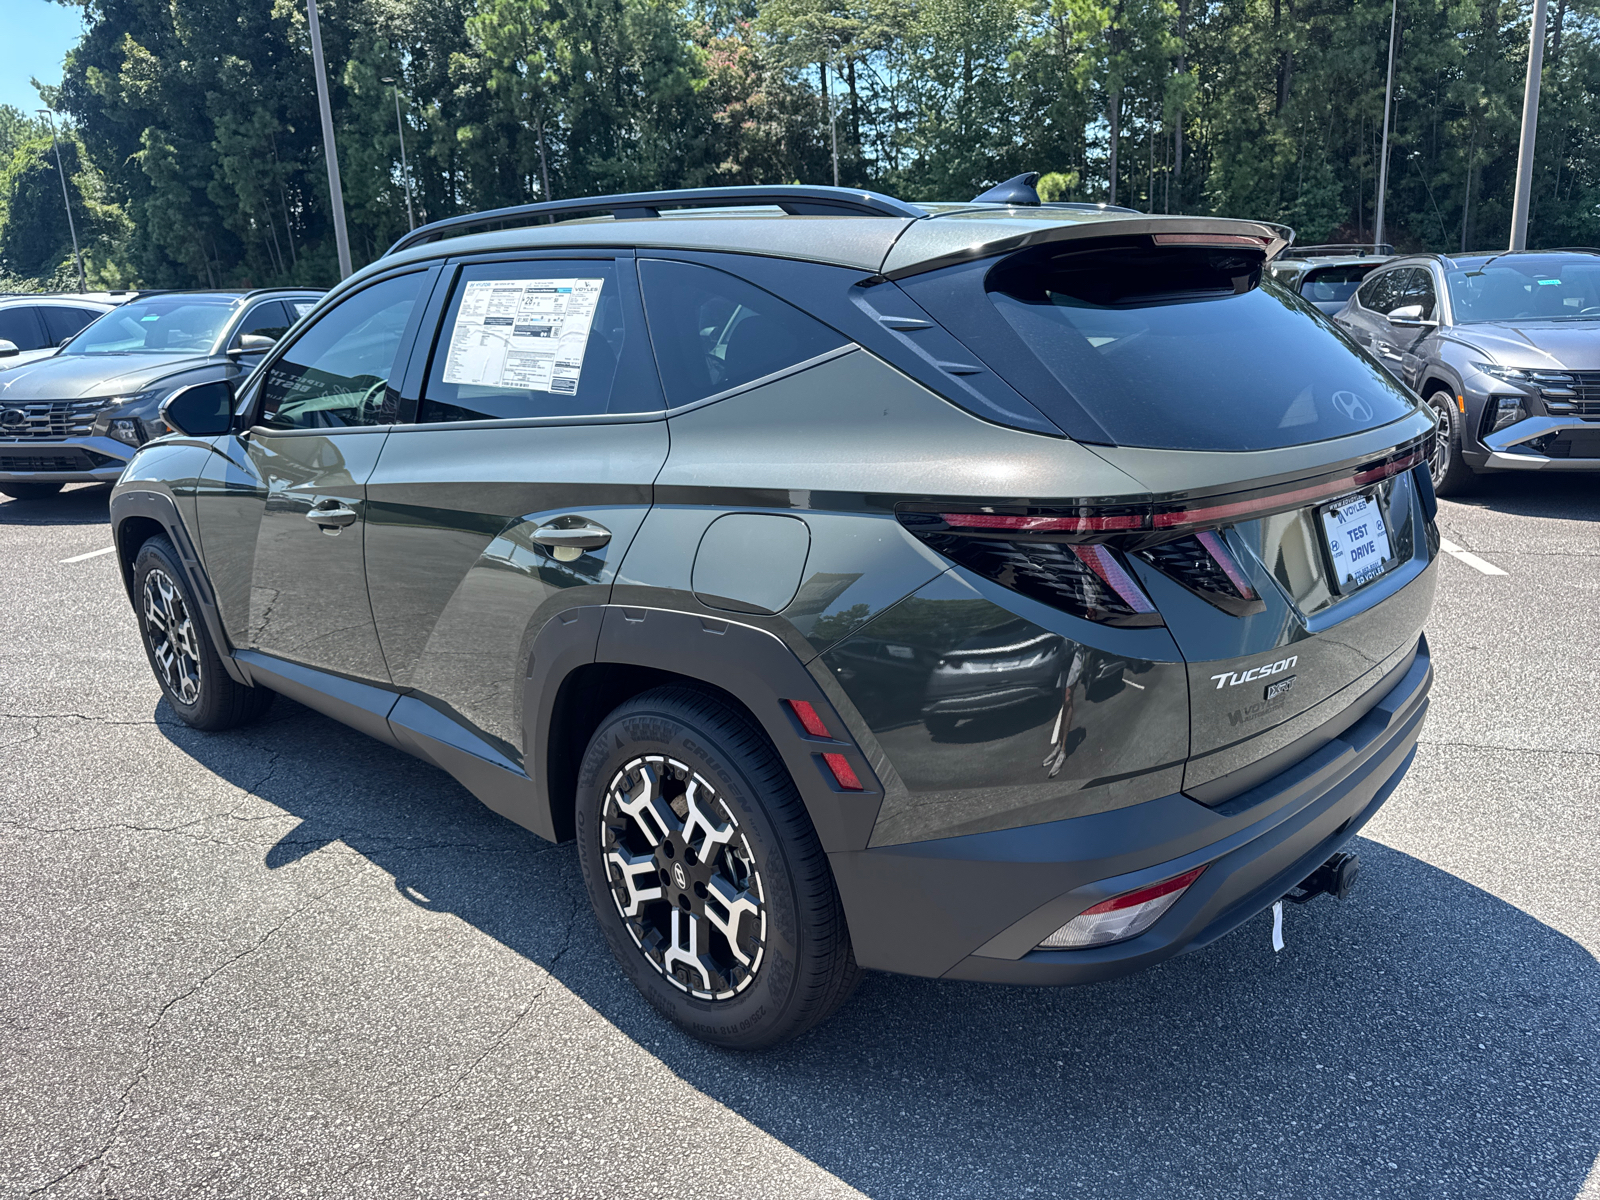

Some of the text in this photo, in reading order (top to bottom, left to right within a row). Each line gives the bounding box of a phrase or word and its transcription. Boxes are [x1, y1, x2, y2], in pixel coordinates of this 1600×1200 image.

[1343, 500, 1367, 517] VOYLES
[1347, 523, 1369, 543] TEST
[1350, 540, 1376, 562] DRIVE
[1356, 566, 1385, 586] ED VOYLES
[1268, 676, 1297, 699] XRT
[1244, 695, 1286, 715] VOYLES
[682, 738, 753, 814] CRUGEN
[577, 810, 597, 896] KUMHO
[692, 1005, 767, 1036] 235/60 R18 103H
